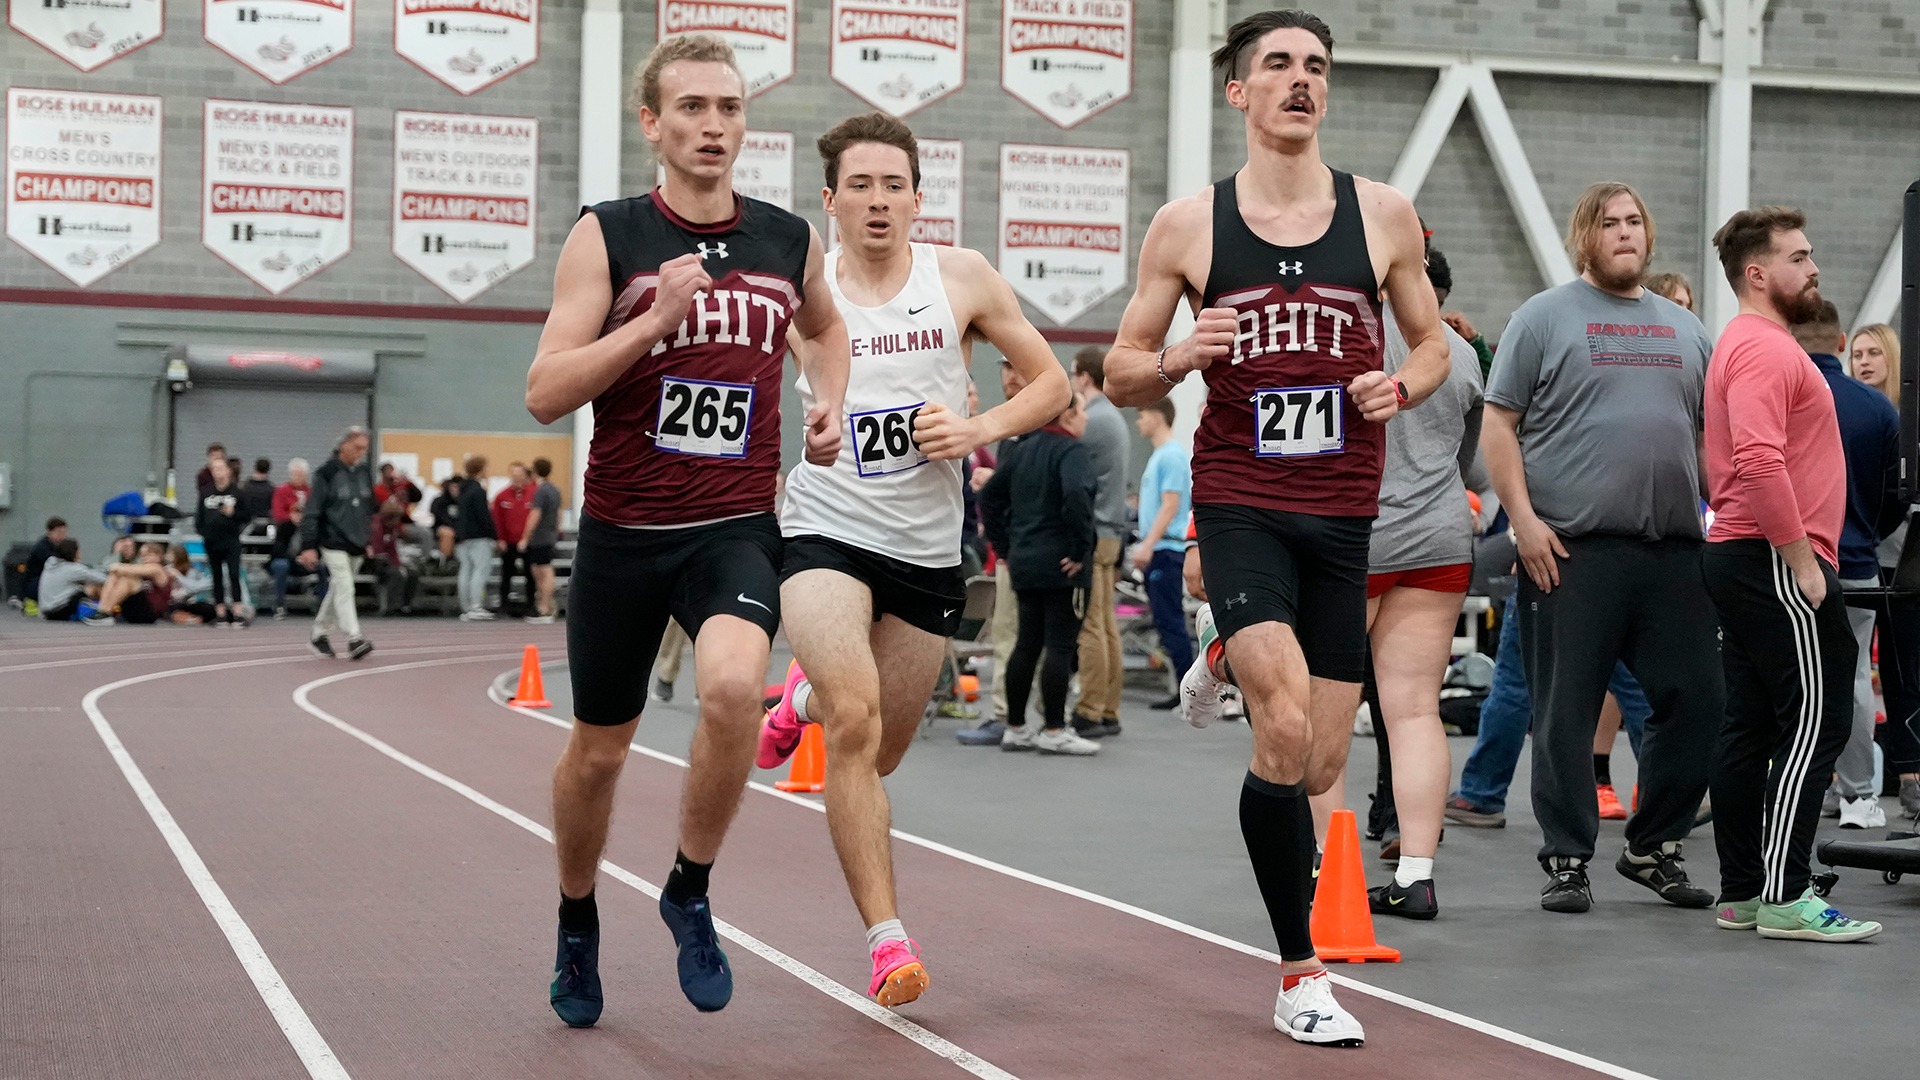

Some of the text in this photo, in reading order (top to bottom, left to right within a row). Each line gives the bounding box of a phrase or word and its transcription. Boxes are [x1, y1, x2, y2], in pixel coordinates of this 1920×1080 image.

[667, 4, 787, 34] CHAMPIONS
[840, 12, 957, 46] CHAMPIONS
[1010, 22, 1125, 57] CHAMPIONS
[58, 129, 112, 146] MEN'S
[219, 139, 340, 159] MEN'S INDOOR
[10, 146, 156, 168] CROSS COUNTRY
[218, 157, 273, 174] TRACK
[294, 161, 340, 178] FIELD
[452, 150, 531, 168] OUTDOOR
[407, 166, 460, 184] TRACK
[480, 171, 525, 187] FIELD
[16, 176, 152, 206] CHAMPIONS
[212, 186, 343, 215] CHAMPIONS
[402, 196, 529, 223] CHAMPIONS
[1005, 224, 1121, 250] CHAMPIONS
[851, 328, 944, 358] E-HULMAN
[1231, 302, 1354, 366] RHIT
[1586, 323, 1677, 339] HANOVER
[1587, 335, 1599, 354] 2023
[659, 383, 750, 442] 265
[1260, 390, 1334, 442] 271
